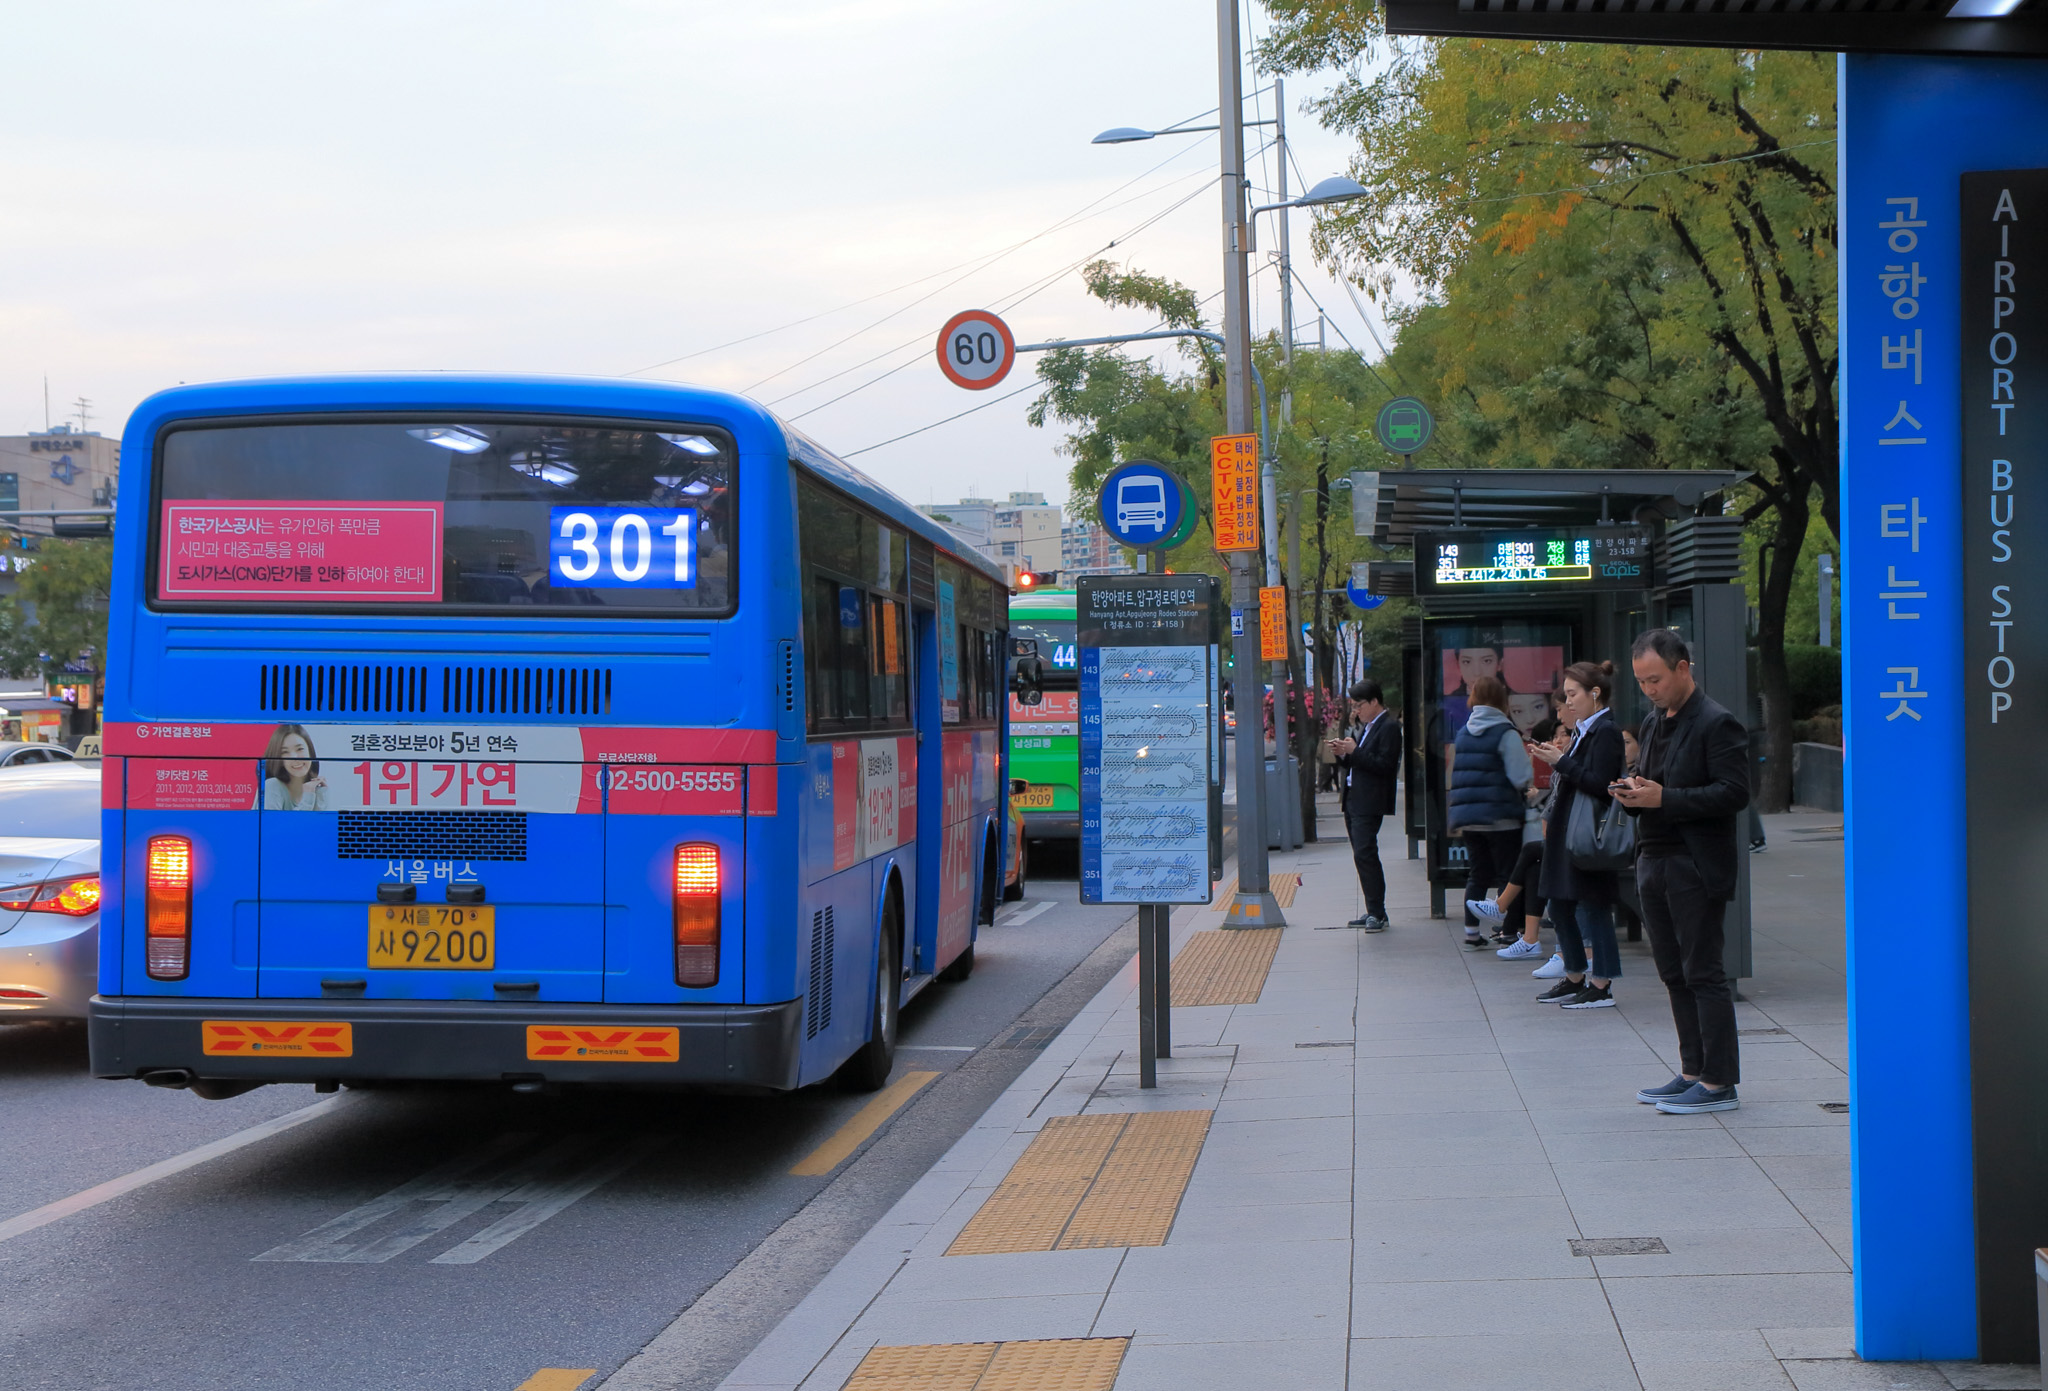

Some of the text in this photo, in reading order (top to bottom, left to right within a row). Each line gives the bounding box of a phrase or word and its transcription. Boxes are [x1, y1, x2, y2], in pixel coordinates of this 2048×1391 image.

[955, 331, 997, 366] 60
[1878, 197, 1928, 722] 공항버스 타는 곳
[1987, 188, 2019, 724] AIRPORT BUS STOP
[178, 516, 381, 536] 한국가스공사는 유가인하 폭만큼
[178, 540, 325, 559] 시민과 대중교통을 위해
[558, 512, 690, 582] 301
[1439, 544, 1459, 557] 143
[1515, 542, 1534, 555] 301
[1438, 557, 1458, 570] 351
[1515, 555, 1536, 567] 362
[177, 565, 313, 583] 도시가스(CNG)단가를
[393, 566, 424, 585] 한다!
[1089, 610, 1114, 620] Hanyang
[1158, 609, 1177, 618] Rodeo
[1178, 609, 1199, 617] Station
[1053, 644, 1077, 668] 44
[1083, 665, 1098, 675] 143
[63, 687, 76, 702] PC
[1083, 714, 1100, 725] 145
[152, 725, 212, 739] 가연결혼정보
[350, 731, 518, 753] 결혼정보분야 5년 연속
[83, 743, 100, 756] TA
[192, 769, 209, 781] 기준
[1083, 767, 1100, 776] 240
[234, 784, 252, 794] 2015
[353, 760, 517, 807] 1위 가연
[595, 770, 736, 797] 02-500-5555
[1084, 819, 1099, 829] 301
[384, 860, 478, 884] 서울버스
[1085, 870, 1100, 880] 351
[400, 908, 464, 926] 서울 70
